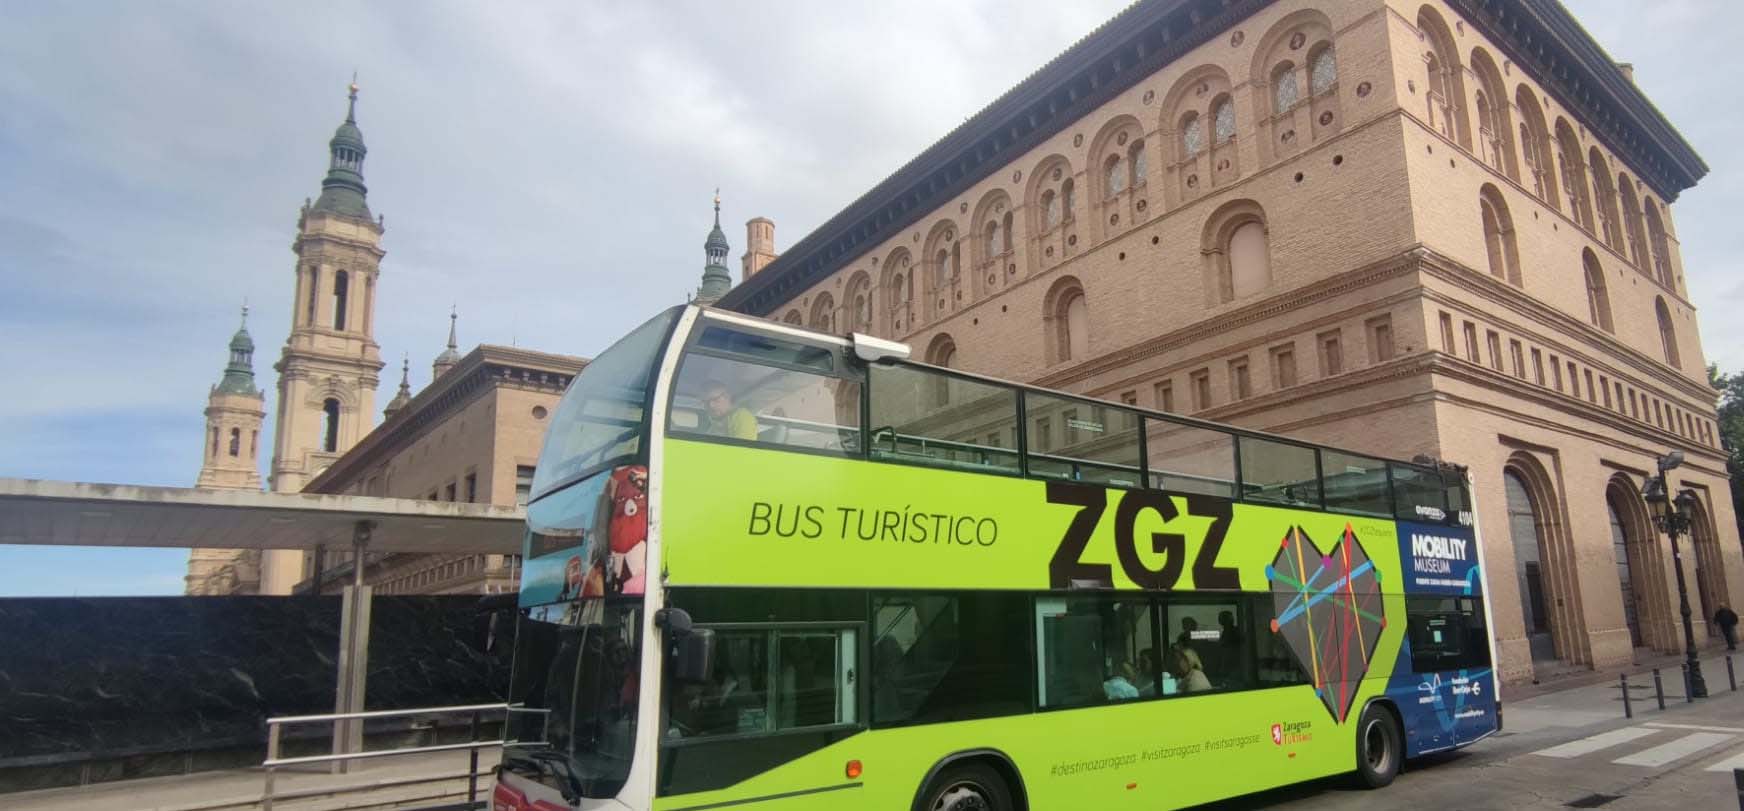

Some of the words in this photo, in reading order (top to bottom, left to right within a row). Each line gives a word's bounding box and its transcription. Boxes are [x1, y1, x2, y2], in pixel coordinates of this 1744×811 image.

[748, 502, 824, 538] BUS
[836, 504, 998, 547] TURÍSTICO
[1045, 481, 1241, 590] ZGZ
[1411, 533, 1467, 560] MOBILITY
[1414, 558, 1451, 574] MUSEUM
[1282, 721, 1311, 733] Zaragoza
[1141, 743, 1201, 763] #visitzaragoza
